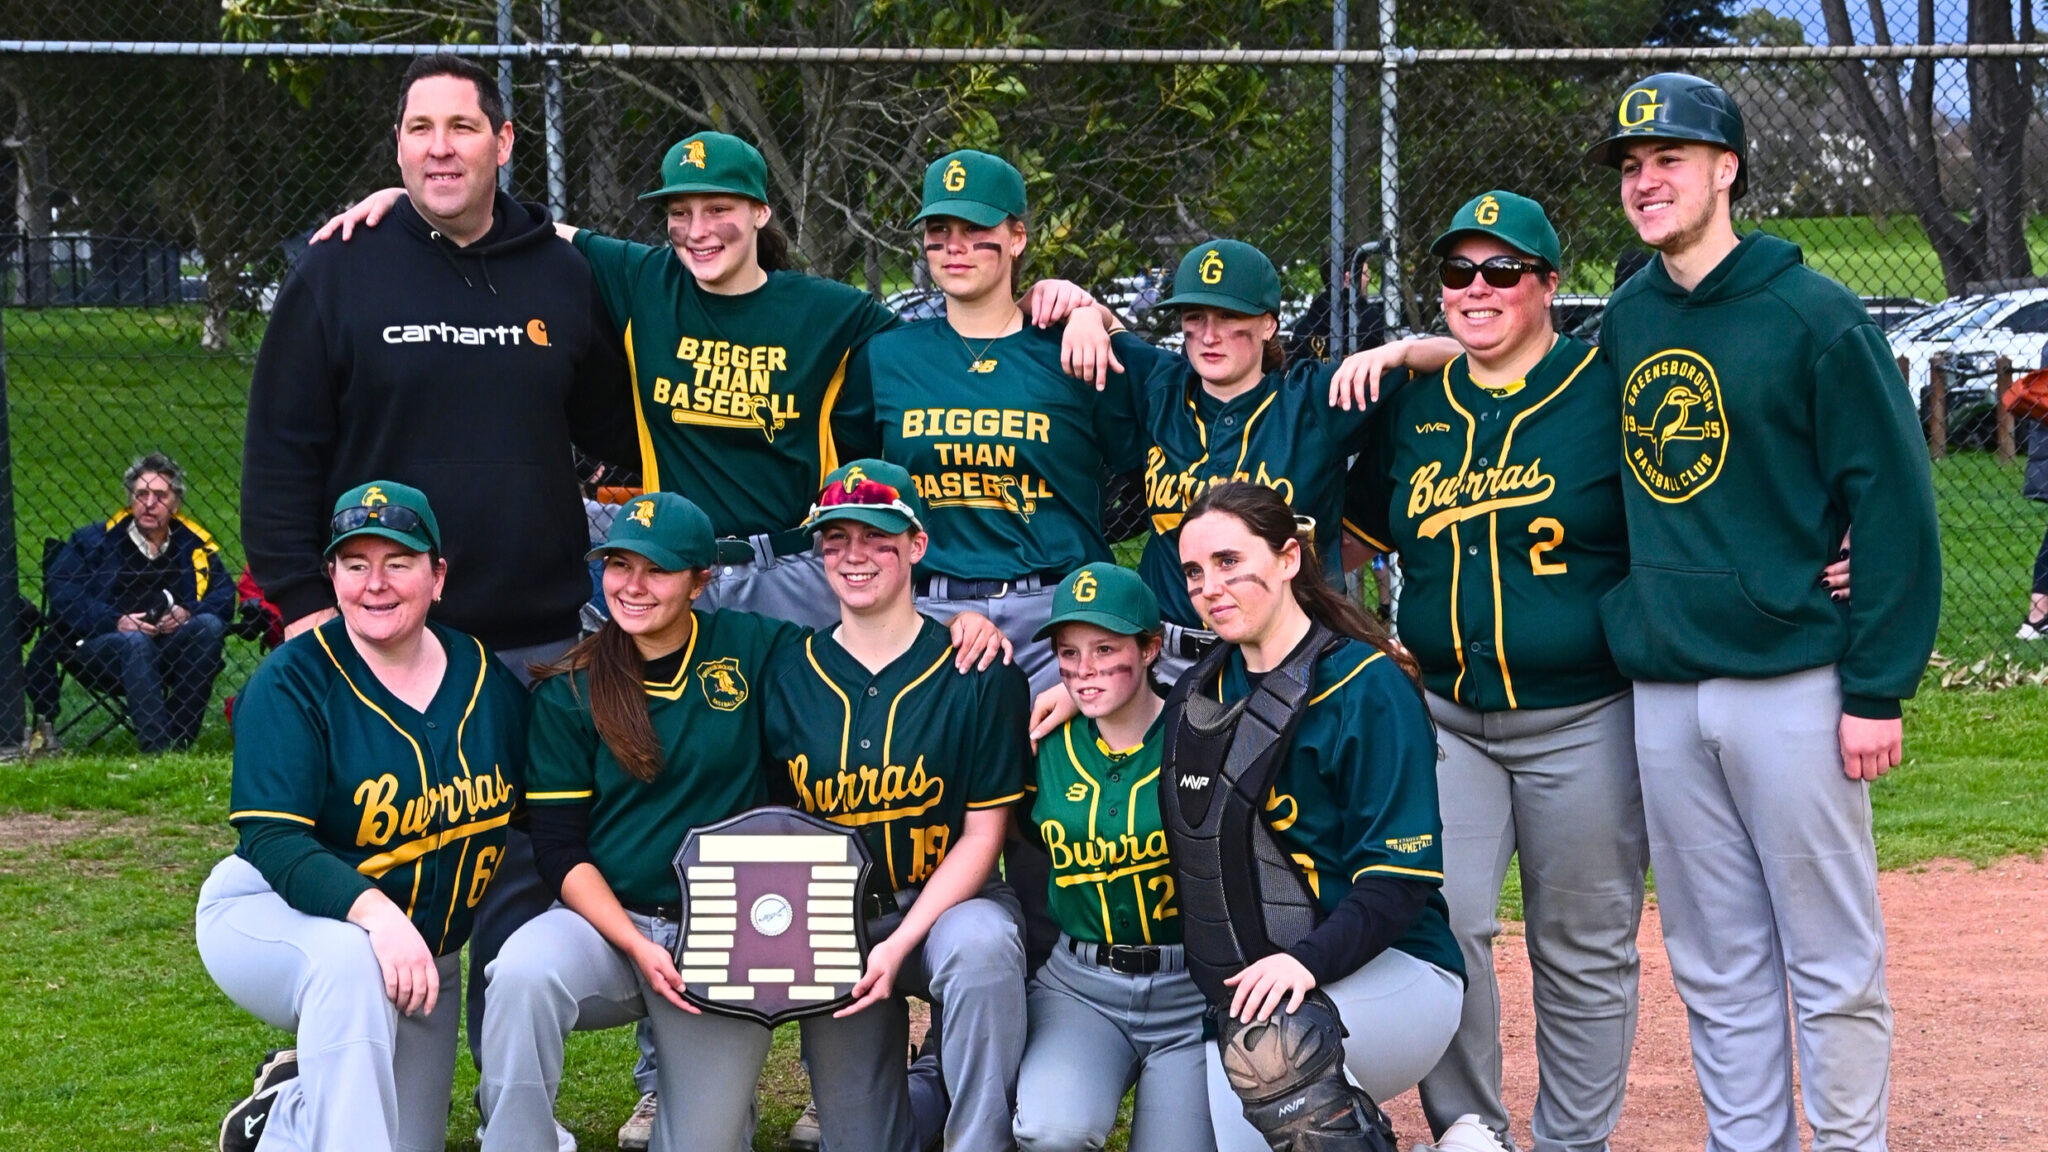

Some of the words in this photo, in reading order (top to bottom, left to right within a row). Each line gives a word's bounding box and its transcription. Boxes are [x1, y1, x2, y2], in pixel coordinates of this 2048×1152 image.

[1618, 88, 1663, 127] G
[944, 164, 967, 192] G
[1476, 198, 1500, 226] G
[1201, 255, 1224, 285] G
[382, 321, 524, 346] carhartt
[676, 336, 788, 372] BIGGER
[692, 361, 770, 395] THAN
[1628, 360, 1715, 413] GREENSBOROUGH
[653, 376, 801, 420] BASEBLL
[902, 408, 1051, 444] BIGGER
[1624, 414, 1637, 433] 19
[933, 443, 1016, 468] THAN
[1633, 447, 1681, 492] BASEBALL
[1679, 453, 1713, 488] CLUB
[911, 471, 1054, 499] ASEBLL
[1407, 457, 1555, 519] Burras
[1527, 516, 1568, 576] 2
[1074, 574, 1098, 603] G
[787, 753, 945, 814] Burras
[1179, 773, 1210, 791] MVP
[353, 763, 516, 847] Burras
[907, 823, 950, 883] 19
[1040, 819, 1170, 870] Burra
[1147, 873, 1179, 921] 2
[1278, 1096, 1306, 1118] MVP
